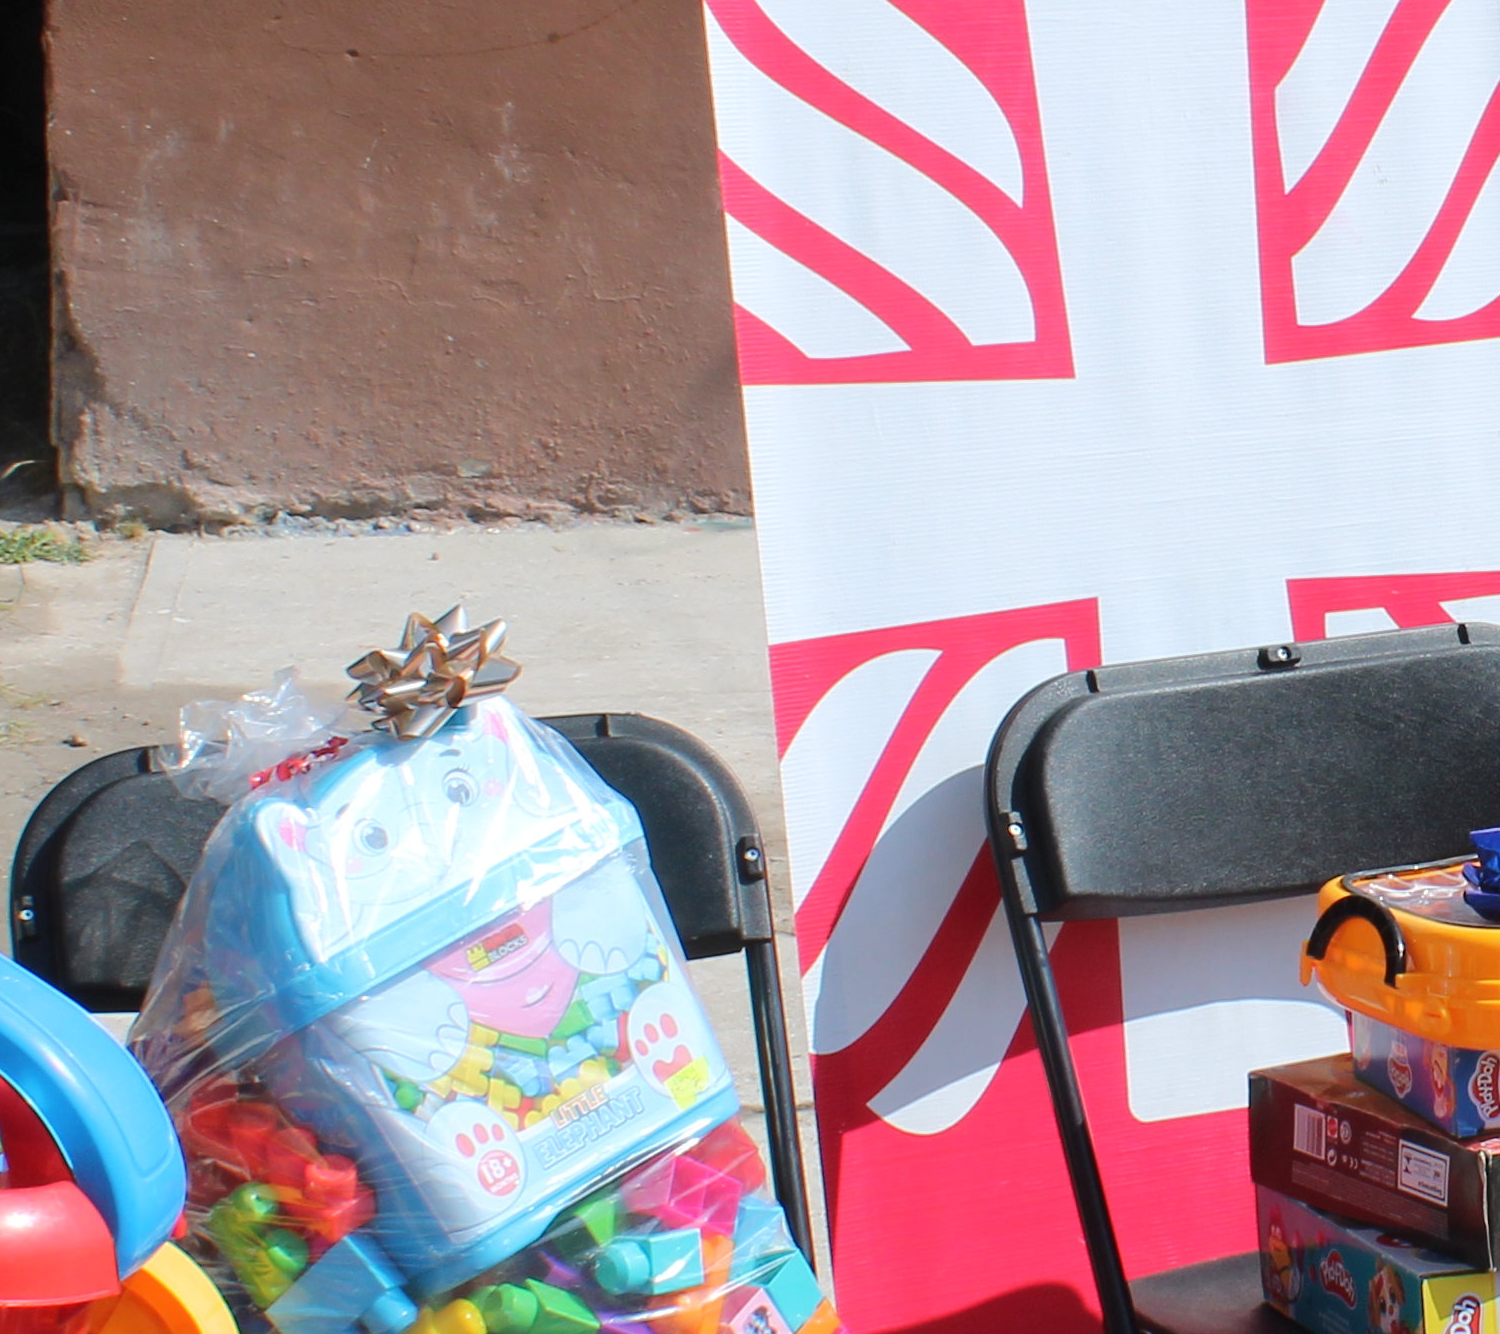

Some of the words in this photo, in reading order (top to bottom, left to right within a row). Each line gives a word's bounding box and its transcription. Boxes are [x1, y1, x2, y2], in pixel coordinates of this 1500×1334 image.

[487, 934, 529, 963] BLOCKS
[548, 1082, 610, 1131] LITTLE
[1477, 1055, 1499, 1118] Play-Doh
[532, 1083, 647, 1171] ELEPHANT
[480, 1156, 514, 1185] 18+
